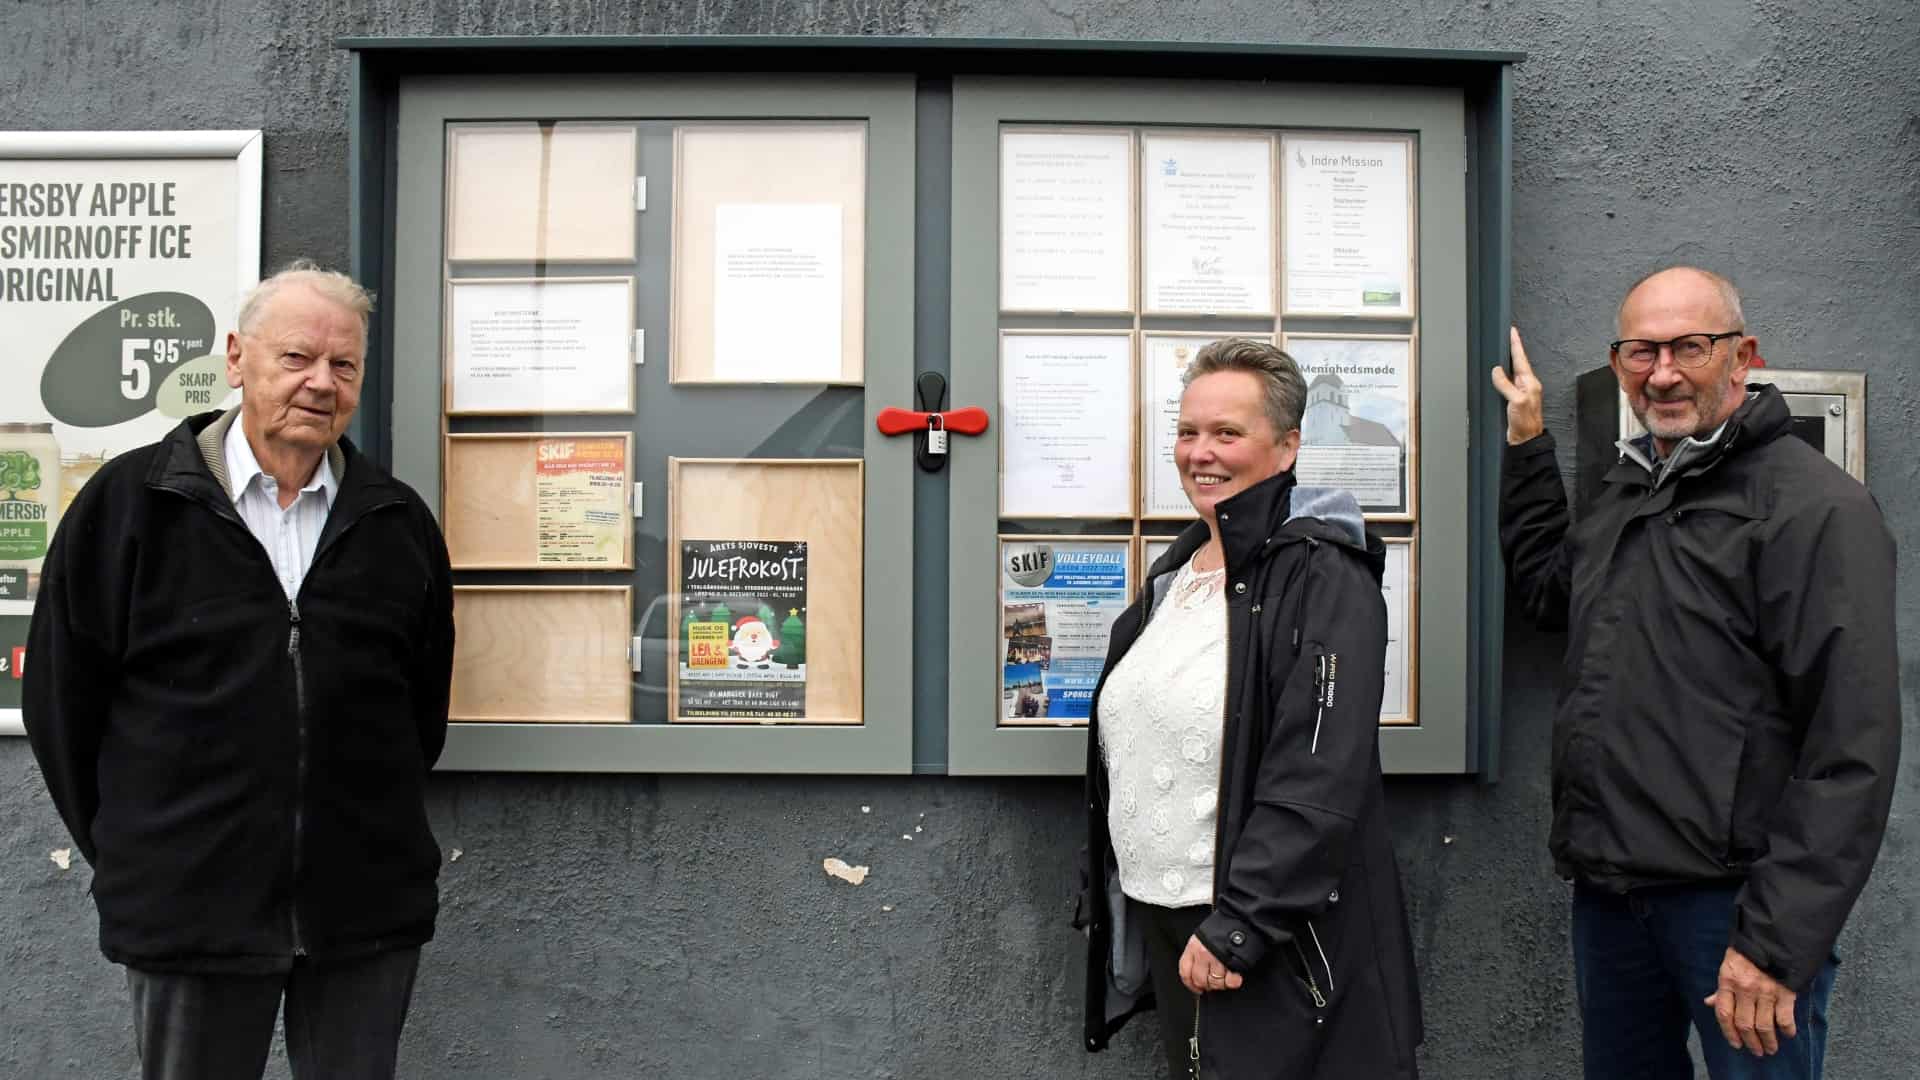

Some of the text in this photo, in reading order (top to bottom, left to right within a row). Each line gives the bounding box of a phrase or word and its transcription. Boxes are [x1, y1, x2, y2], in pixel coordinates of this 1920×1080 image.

[1311, 155, 1384, 168] Indre Mission
[89, 182, 176, 217] APPLE
[1, 225, 192, 259] SMIRNOFF ICE
[0, 267, 119, 302] RIGINAL
[120, 307, 181, 328] Pr. stk.
[179, 373, 216, 387] SKARP
[185, 390, 210, 403] PRIS
[538, 442, 576, 462] SKIF
[1011, 552, 1048, 572] SKIF
[1057, 553, 1120, 564] VOLLEYBALL
[691, 642, 711, 656] LEA
